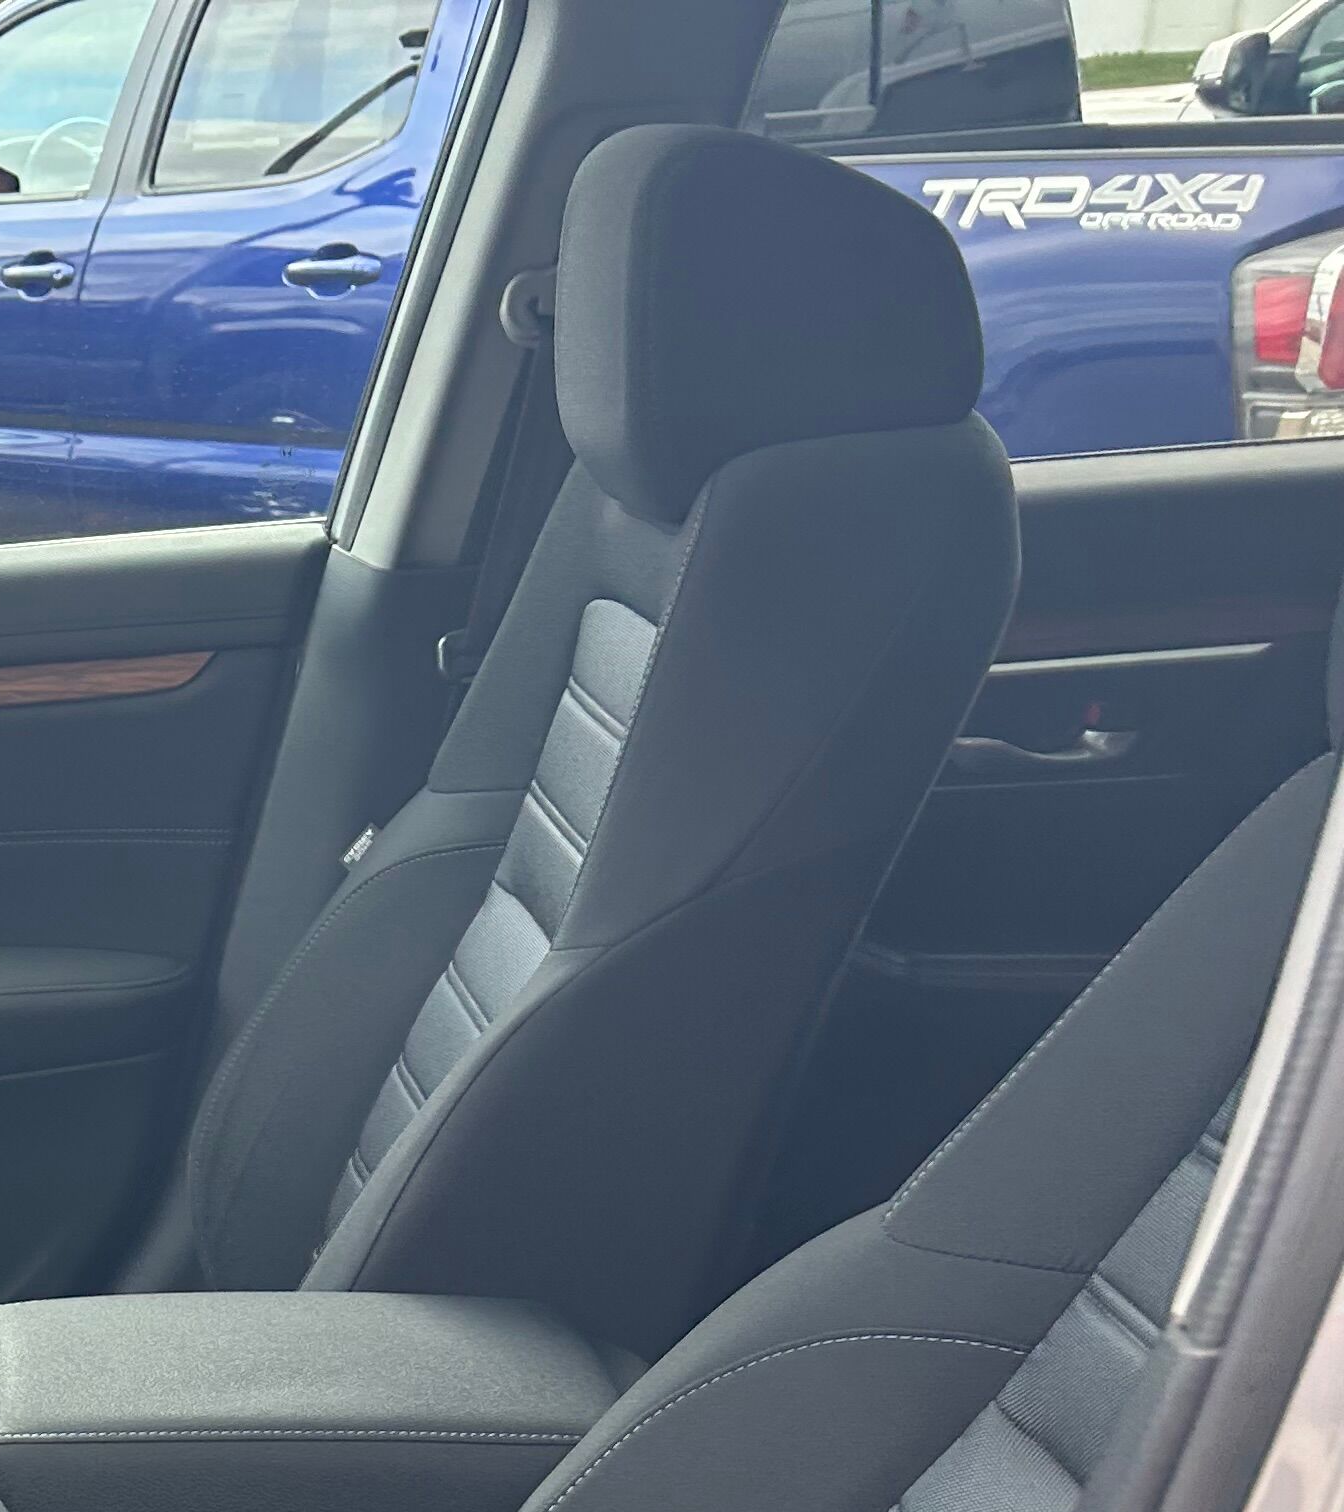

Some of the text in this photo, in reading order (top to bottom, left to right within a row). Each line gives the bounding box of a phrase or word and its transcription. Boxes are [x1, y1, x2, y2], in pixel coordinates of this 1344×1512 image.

[922, 173, 1265, 229] TRD 4X4
[1080, 211, 1242, 231] OFF ROAD
